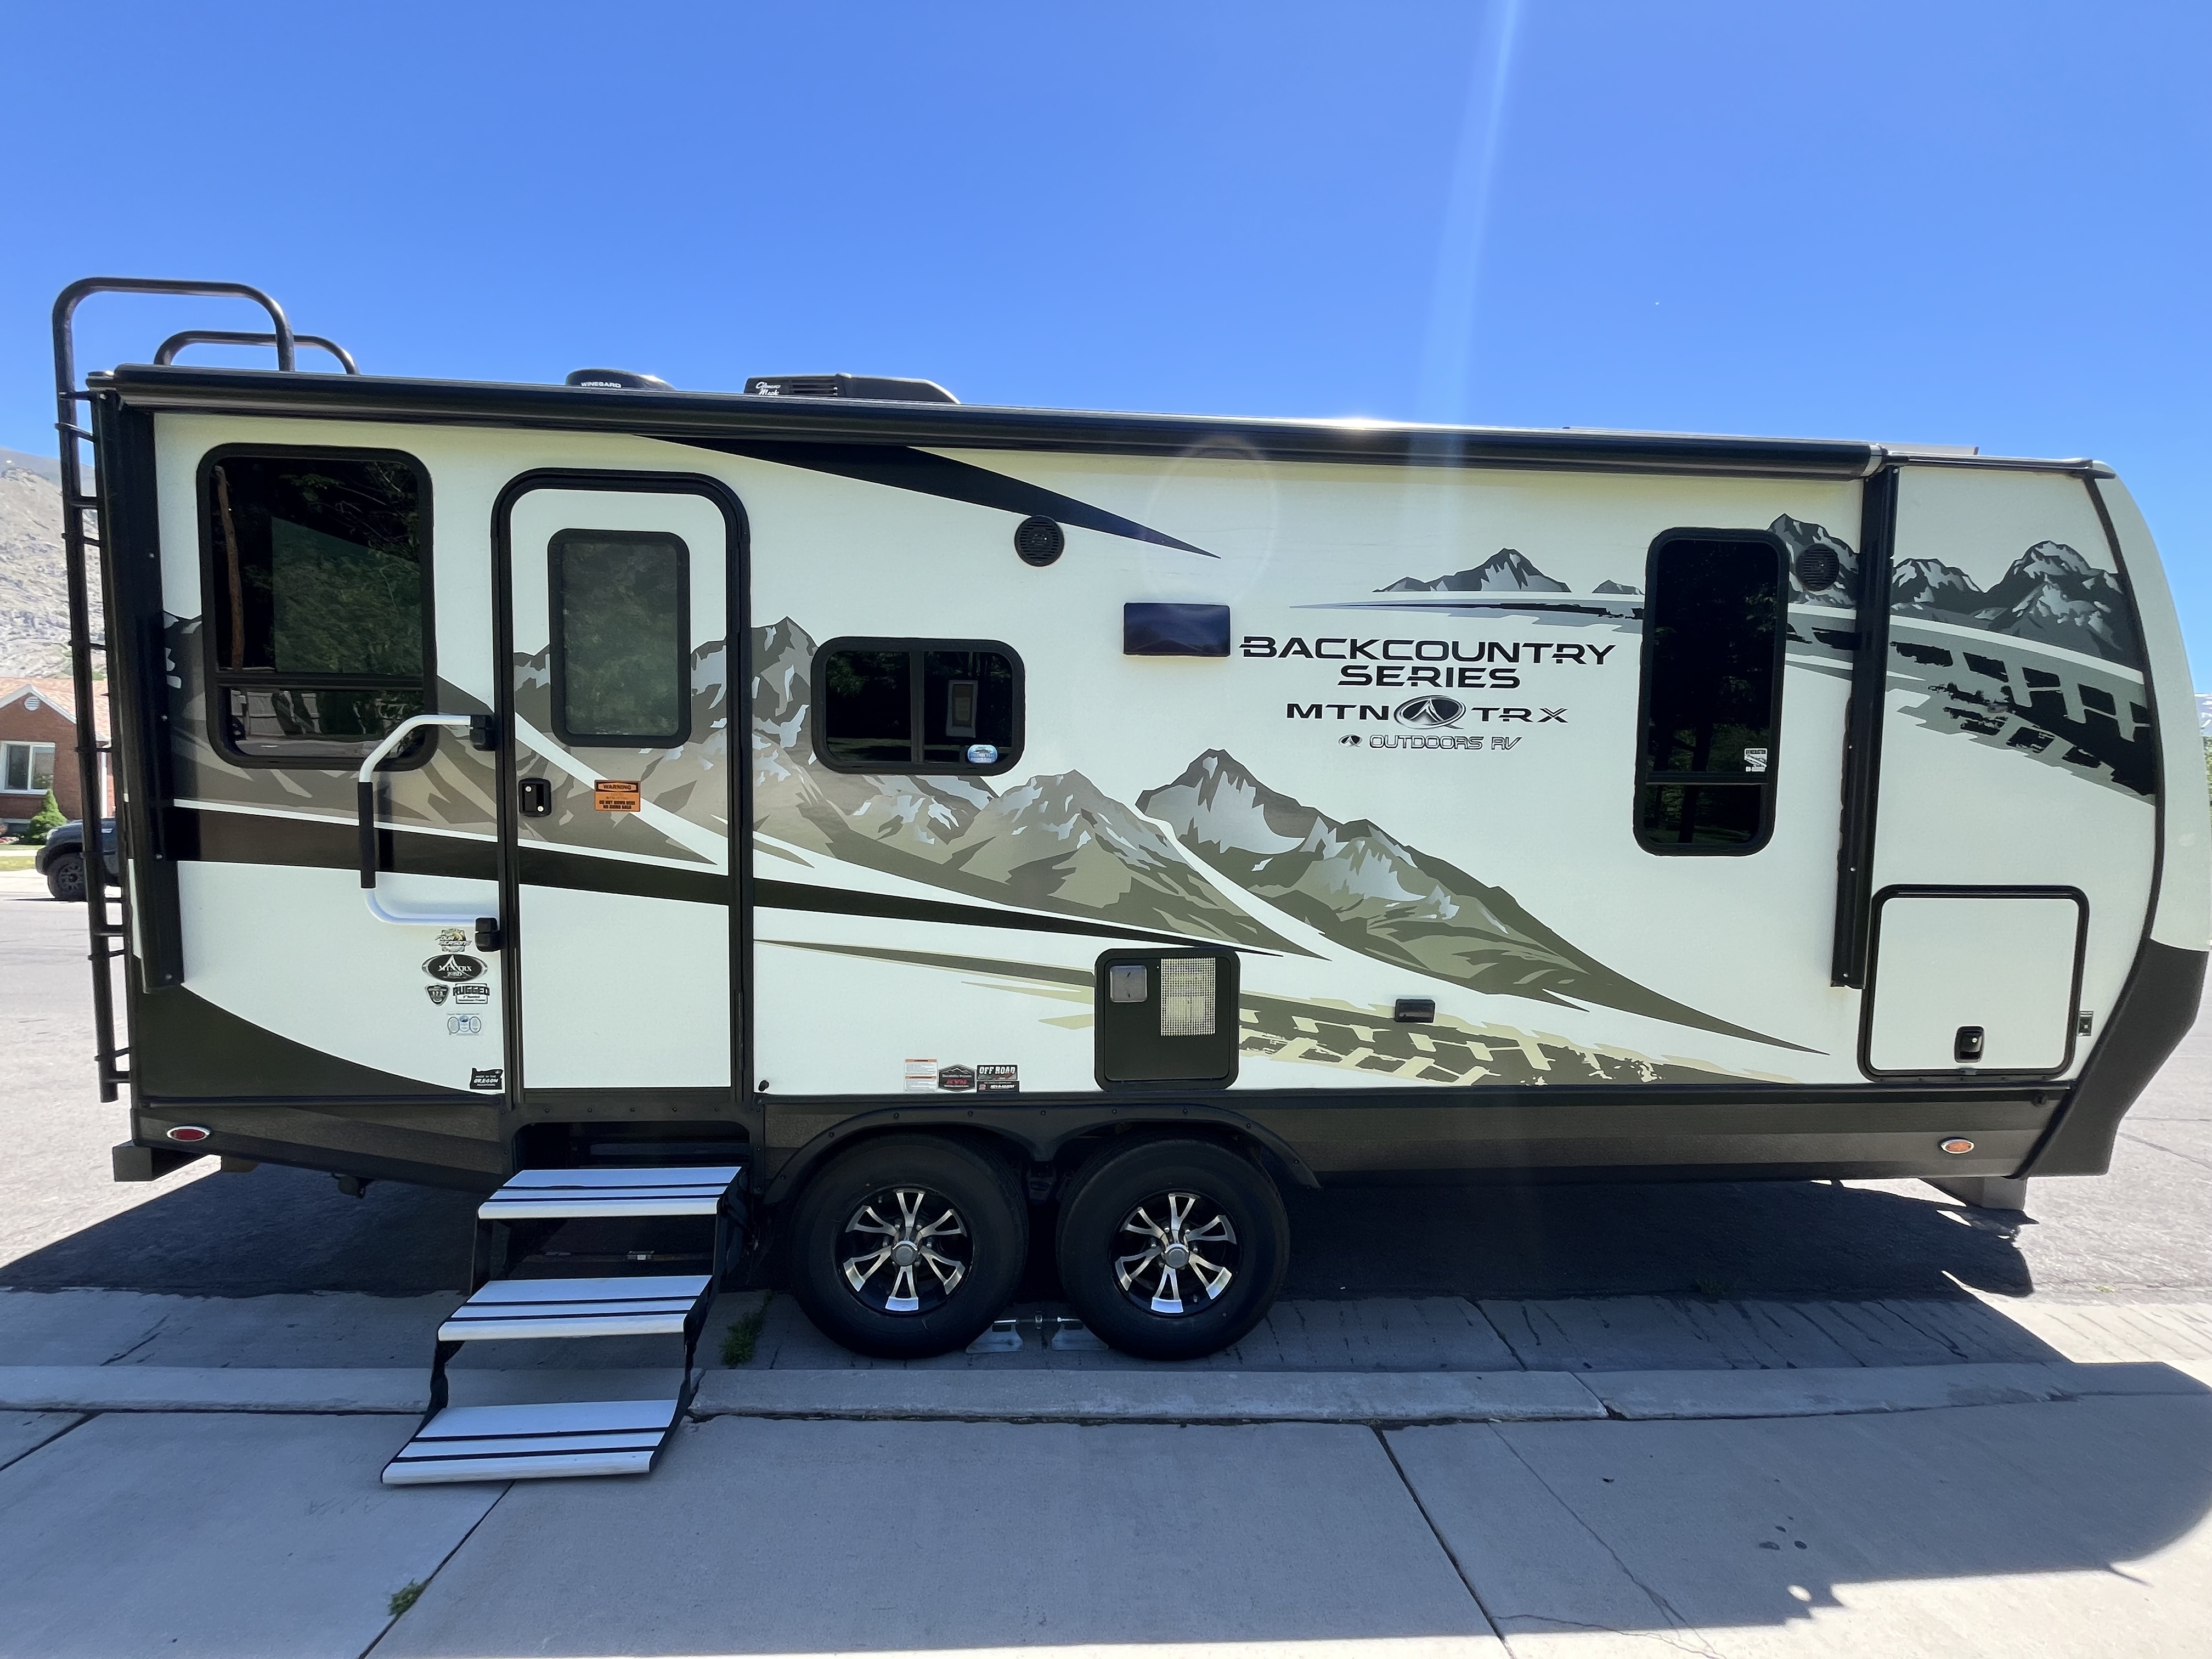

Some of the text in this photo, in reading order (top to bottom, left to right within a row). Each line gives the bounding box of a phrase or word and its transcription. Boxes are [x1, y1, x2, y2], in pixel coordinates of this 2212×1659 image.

[1239, 636, 1616, 665] BACKCOUNTRY
[1337, 665, 1521, 689] SERIES
[1286, 703, 1568, 723] MTN TRX
[1369, 735, 1522, 750] OUTDOORS RV
